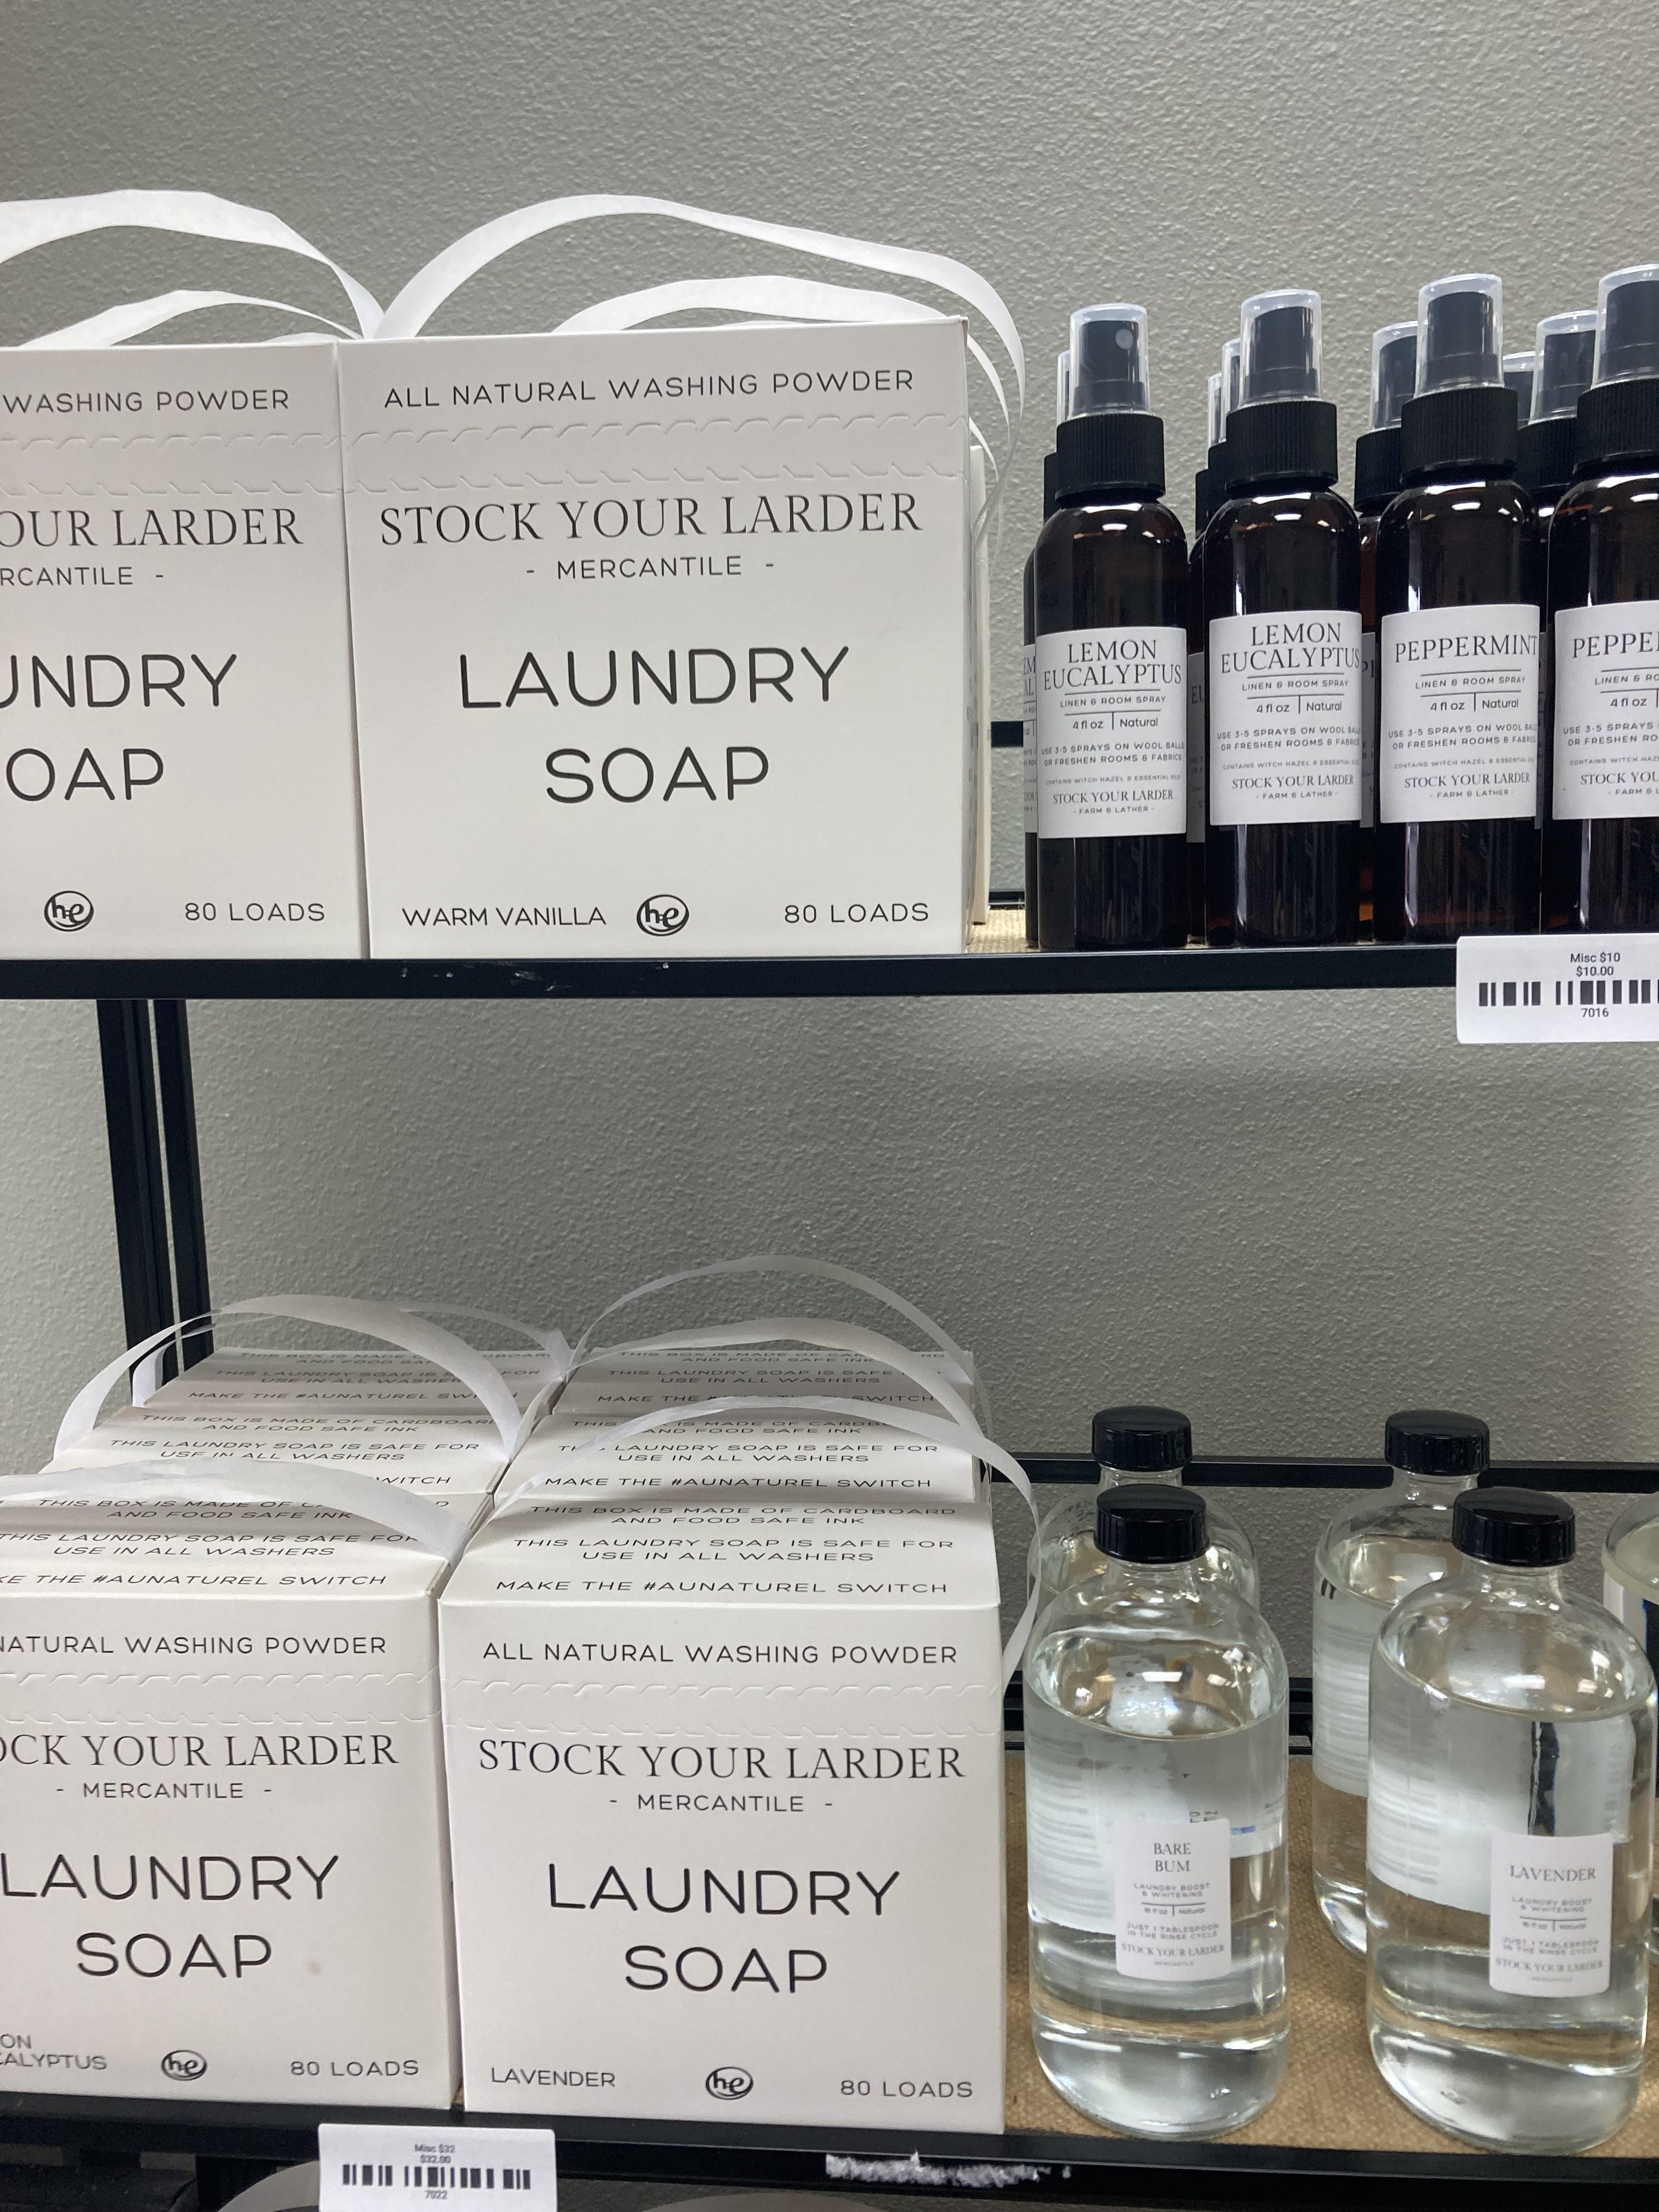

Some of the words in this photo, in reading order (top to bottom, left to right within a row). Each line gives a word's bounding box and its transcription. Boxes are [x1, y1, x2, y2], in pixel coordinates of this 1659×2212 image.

[384, 386, 440, 409] ALL
[453, 380, 596, 406] NATURAL
[608, 374, 757, 399] WASHING
[773, 369, 913, 394] POWDER
[2, 391, 142, 414] WASHING
[156, 389, 289, 411] POWDER
[112, 508, 303, 546] LARDER
[381, 502, 544, 546] STOCK
[556, 498, 707, 539] YOUR
[722, 493, 922, 535] LARDER
[557, 555, 741, 580] MERCANTILE
[1251, 622, 1341, 646] LEMON
[1068, 640, 1156, 664] LEMON
[1395, 634, 1537, 663] PEPPERMINT
[1221, 647, 1361, 674] EUCALYPTUS
[460, 646, 849, 709] LAUNDRY
[1043, 663, 1182, 691] EUCALYPTUS
[1242, 681, 1272, 692] LINEN
[1288, 680, 1318, 689] ROOM
[1322, 679, 1348, 687] SPRAY
[1415, 679, 1447, 690] LINEN
[1463, 676, 1494, 686] ROOM
[1498, 675, 1526, 684] SPRAY
[1060, 698, 1086, 708] LINEN
[1101, 696, 1132, 705] ROOM
[1136, 695, 1166, 704] SPRAY
[1256, 704, 1263, 714] 4
[1266, 703, 1273, 713] fl
[1276, 704, 1290, 713] oz
[1306, 701, 1342, 712] Natural
[1430, 702, 1437, 712] 4
[1440, 701, 1447, 712] fl
[1451, 702, 1465, 711] oz
[1482, 699, 1519, 709] Natural
[1073, 720, 1079, 730] 4
[1081, 720, 1087, 730] fl
[1090, 721, 1103, 730] oz
[1120, 718, 1158, 727] Natural
[1041, 747, 1053, 755] USE
[1070, 743, 1110, 753] SPRAYS
[1114, 742, 1129, 751] ON
[1133, 741, 1163, 750] WOOL
[1044, 759, 1052, 767] OR
[1054, 756, 1096, 766] FRESHEN
[1101, 754, 1138, 764] ROOMS
[1152, 753, 1182, 762] FABRICS
[5, 747, 164, 802] OAP
[545, 746, 769, 804] SOAP
[1053, 792, 1088, 804] STOCK
[1091, 791, 1128, 803] YOUR
[1132, 789, 1173, 801] LARDER
[185, 902, 217, 921] 80
[229, 902, 325, 922] LOADS
[402, 907, 488, 927] WARM
[495, 906, 607, 926] VANILLA
[785, 904, 817, 924] 80
[831, 902, 928, 923] LOADS
[1570, 952, 1596, 963] Misc
[1600, 951, 1621, 964] $10
[1576, 965, 1614, 978] $10.00
[1581, 1007, 1609, 1018] 7016
[545, 1478, 608, 1486] MAKE
[619, 1477, 662, 1486] THE
[671, 1477, 828, 1489] #AUNATUREL
[835, 1478, 932, 1489] SWITCH
[531, 1505, 583, 1514] THIS
[592, 1505, 645, 1515] BOX
[651, 1505, 674, 1515] IS
[684, 1505, 751, 1515] MADE
[804, 1505, 955, 1515] CARDBOARD
[514, 1539, 568, 1547] THIS
[579, 1538, 699, 1547] LAUNDRY
[709, 1539, 780, 1547] SOAP
[823, 1539, 889, 1548] SAFE
[902, 1540, 953, 1548] FOR
[583, 1551, 634, 1560] USE
[645, 1551, 668, 1560] IN
[678, 1552, 726, 1560] ALL
[739, 1552, 873, 1561] WASHERS
[36, 1575, 86, 1584] THE
[93, 1575, 267, 1585] #AUNATUREL
[279, 1575, 386, 1585] SWITCH
[496, 1581, 571, 1590] MAKE
[582, 1581, 633, 1591] THE
[644, 1581, 826, 1593] #AUNATUREL
[838, 1583, 946, 1593] SWITCH
[125, 1636, 252, 1655] WASHING
[266, 1637, 386, 1655] POWDER
[483, 1642, 533, 1661] ALL
[545, 1643, 674, 1662] NATURAL
[685, 1645, 818, 1664] WASHING
[832, 1645, 956, 1664] POWDER
[81, 1735, 212, 1767] YOUR
[224, 1734, 400, 1767] LARDER
[479, 1739, 625, 1776] STOCK
[637, 1746, 771, 1779] YOUR
[787, 1747, 964, 1779] LARDER
[83, 1782, 244, 1799] MERCANTILE
[638, 1793, 804, 1812] MERCANTILE
[1154, 1843, 1192, 1855] BARE
[1155, 1860, 1190, 1872] BUM
[1510, 1865, 1596, 1882] LAVENDER
[1, 1853, 339, 1901] LAUNDRY
[549, 1863, 900, 1916] LAUNDRY
[76, 1932, 272, 1979] SOAP
[625, 1945, 827, 1994] SOAP
[290, 2061, 320, 2076] 80
[331, 2059, 419, 2077] LOADS
[491, 2067, 615, 2087] LAVENDER
[840, 2080, 871, 2096] 80
[883, 2081, 973, 2098] LOADS
